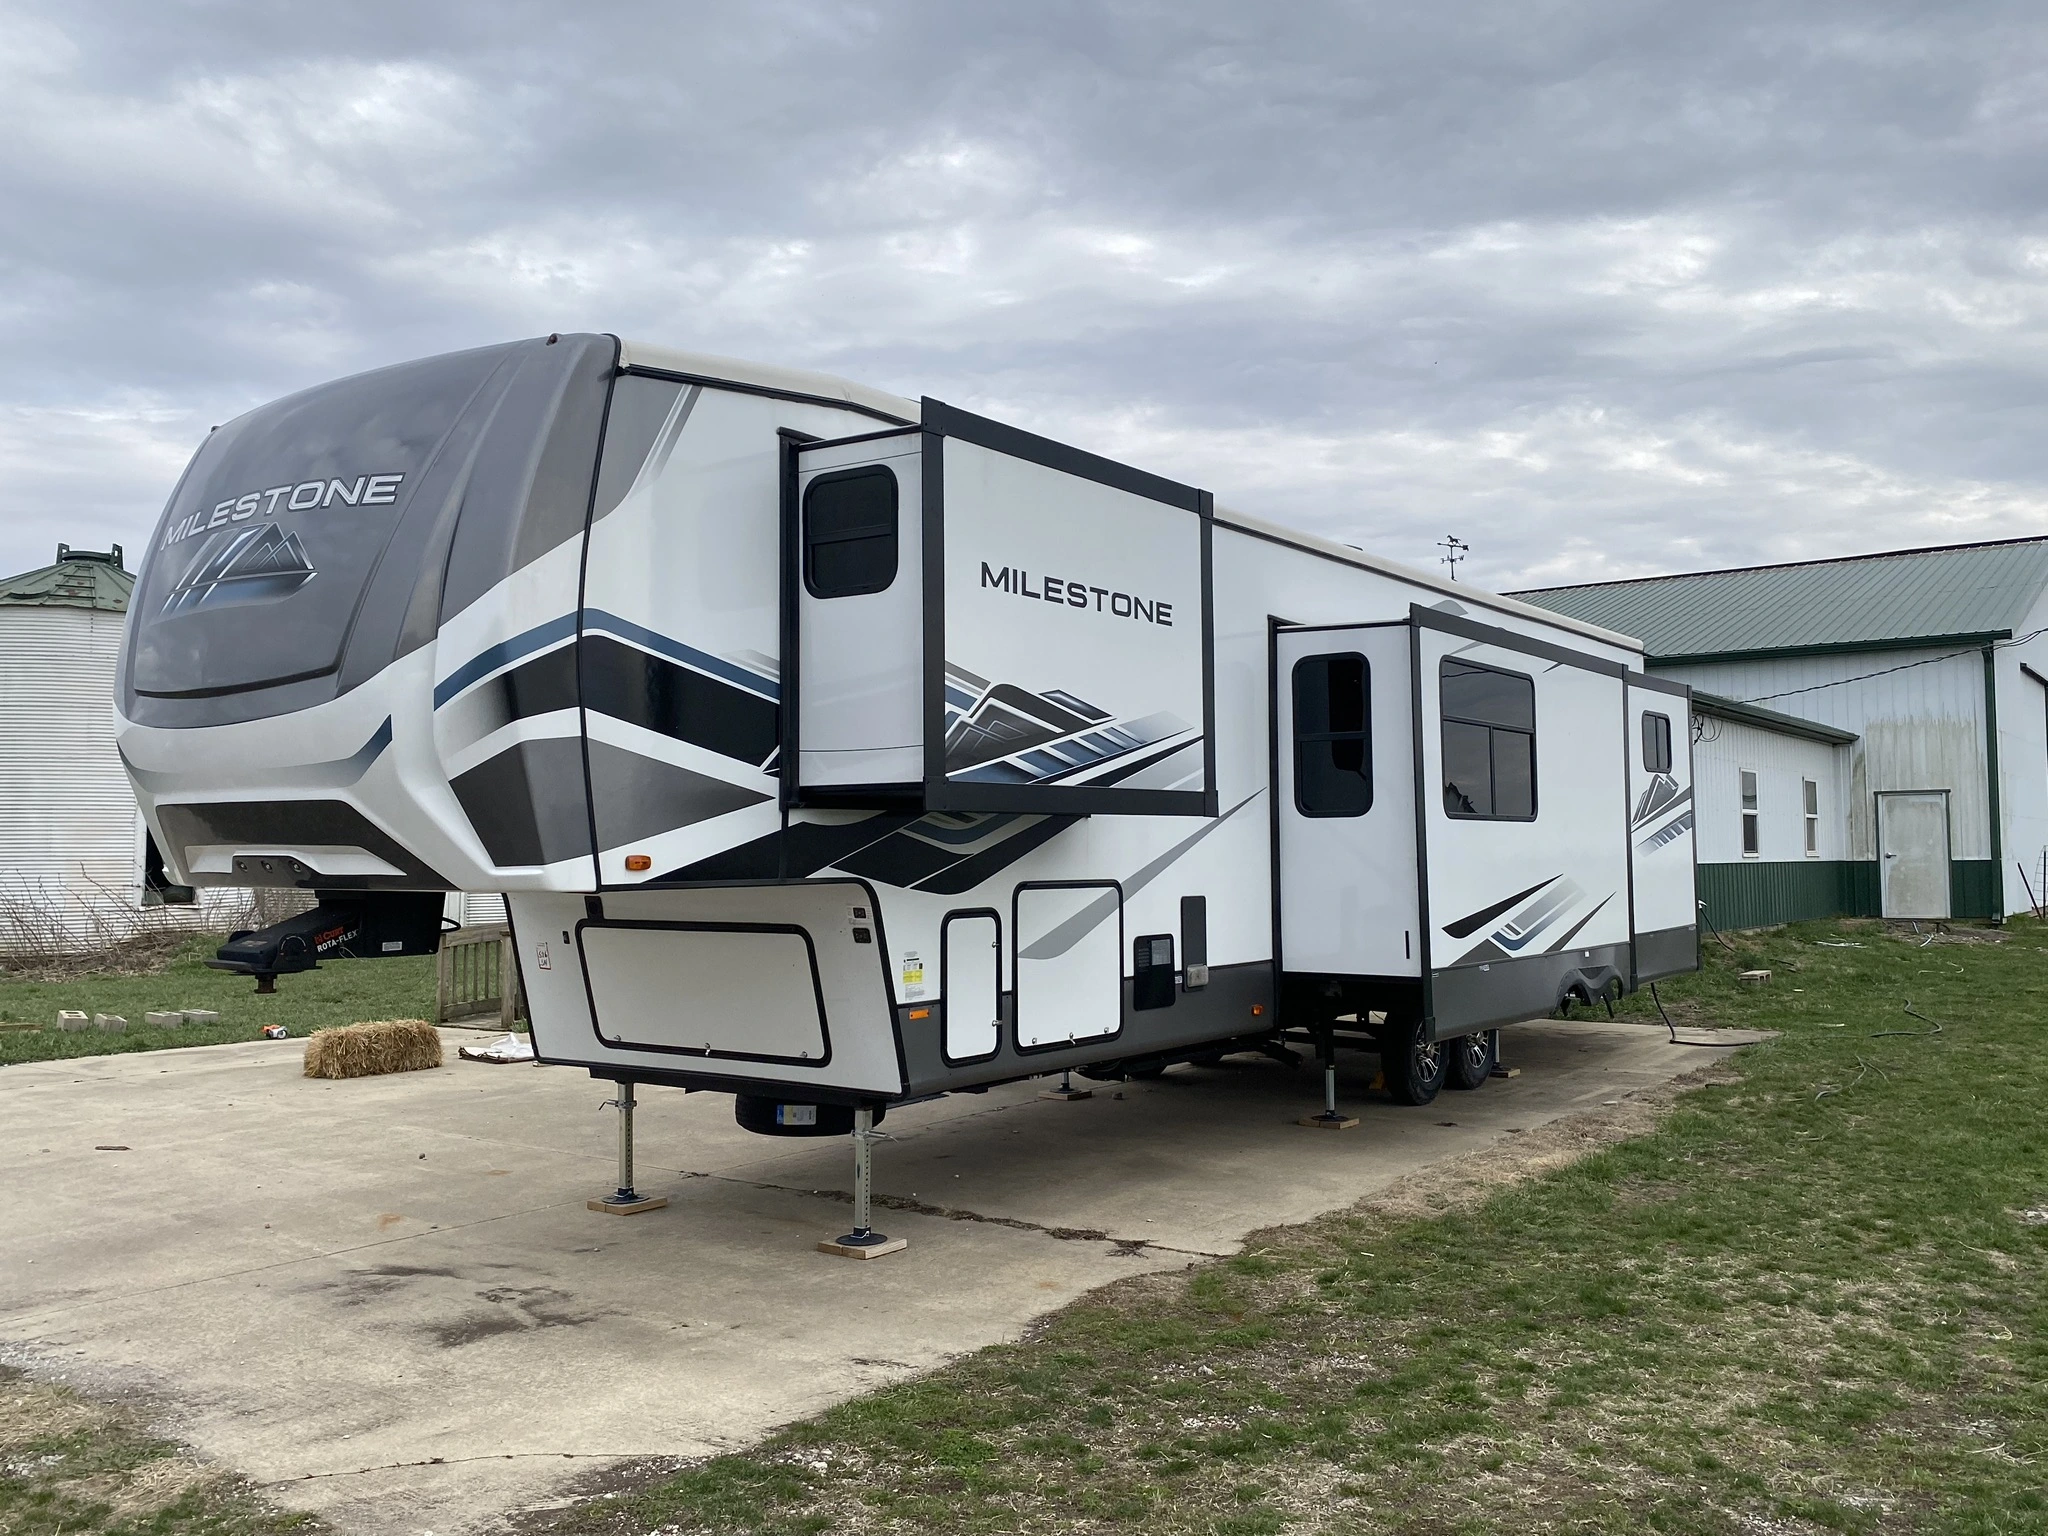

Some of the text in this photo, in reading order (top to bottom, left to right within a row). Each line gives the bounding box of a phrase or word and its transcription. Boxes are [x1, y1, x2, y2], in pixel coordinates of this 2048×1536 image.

[160, 472, 405, 550] MILESTONE
[981, 561, 1173, 627] MILESTONE
[316, 929, 358, 952] ROTA-FLEX
